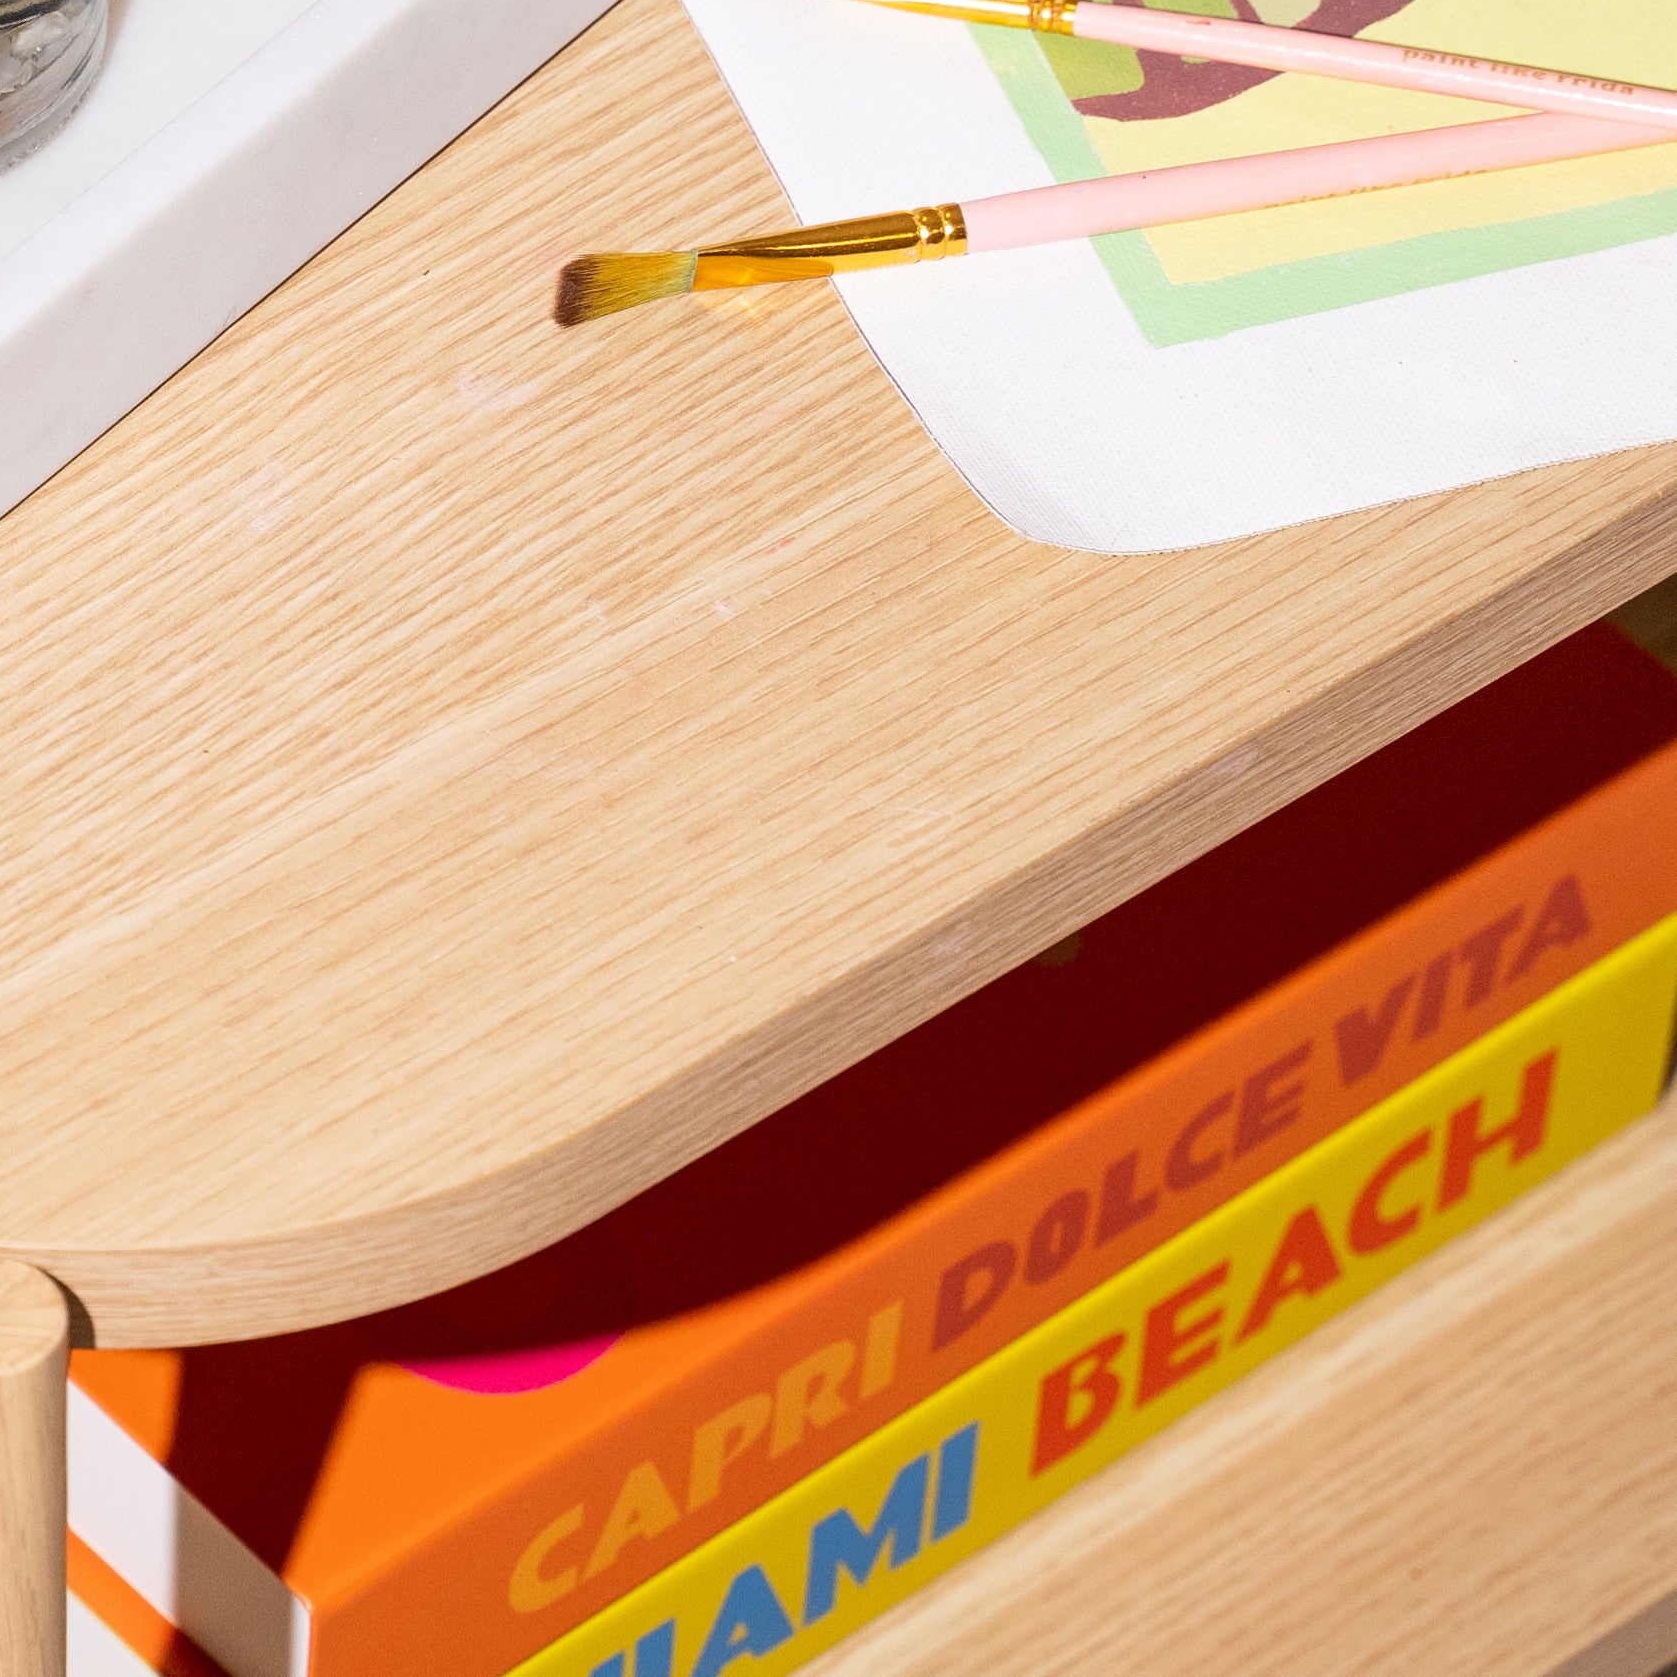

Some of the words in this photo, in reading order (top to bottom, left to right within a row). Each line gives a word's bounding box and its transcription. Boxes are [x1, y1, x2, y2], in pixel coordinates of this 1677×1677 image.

[508, 1298, 905, 1614] CAPRI
[929, 1040, 1315, 1355] DOLCE
[1332, 872, 1592, 1090] VITA
[1027, 1044, 1562, 1480] BEACH
